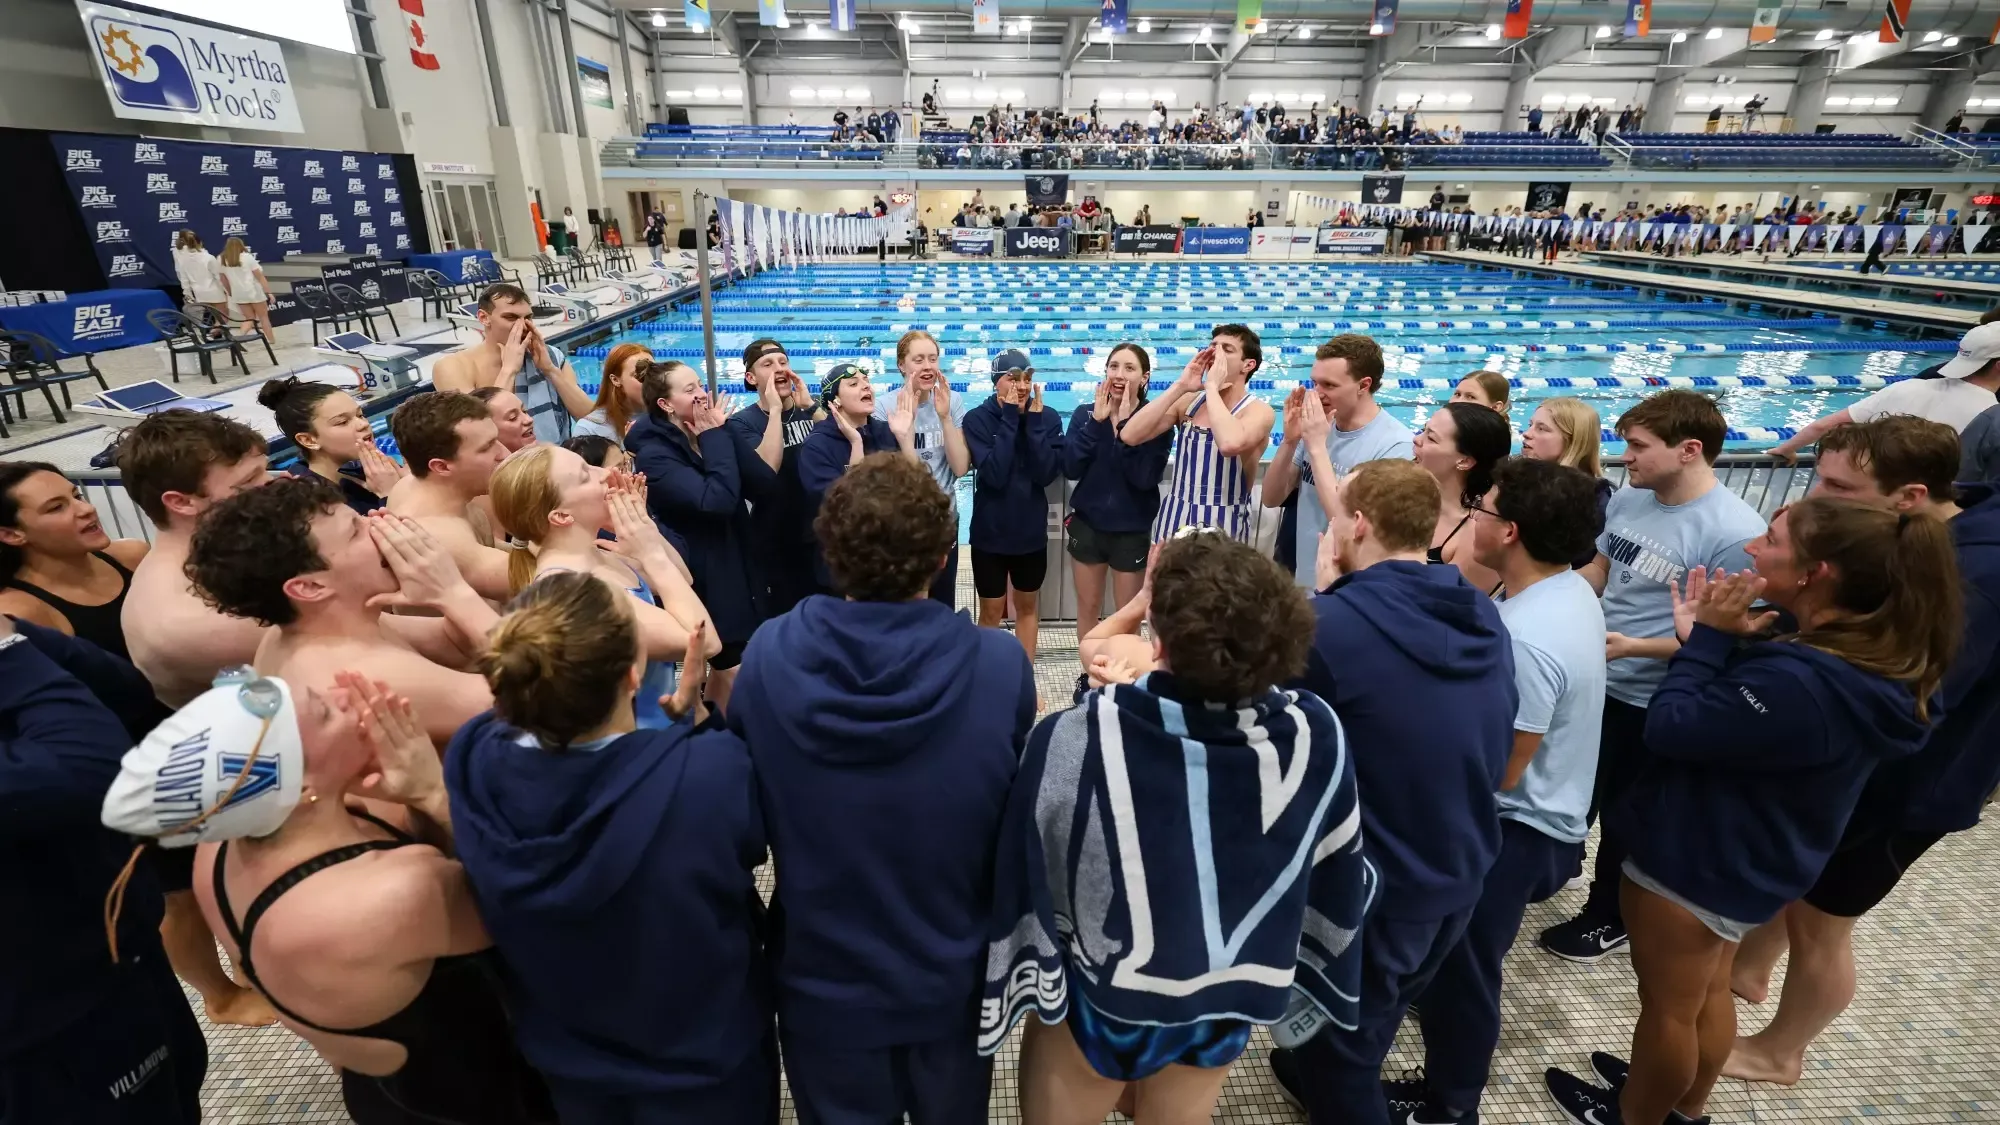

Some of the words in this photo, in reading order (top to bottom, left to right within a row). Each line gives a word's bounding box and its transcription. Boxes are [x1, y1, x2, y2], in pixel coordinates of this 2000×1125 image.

[188, 37, 286, 84] Myrtha
[136, 143, 157, 152] BIG
[67, 150, 92, 158] BIG
[135, 152, 166, 160] EAST
[254, 150, 272, 158] BIG
[66, 158, 102, 167] EAST
[202, 156, 222, 164] BIG
[201, 163, 229, 171] EAST
[147, 173, 168, 182] BIG
[82, 186, 107, 195] BIG
[212, 186, 231, 194] BIG
[82, 194, 116, 203] EAST
[212, 194, 238, 202] EAST
[159, 202, 179, 211] BIG
[270, 201, 286, 209] BIG
[159, 210, 188, 218] EAST
[97, 221, 121, 230] BIG
[223, 224, 248, 232] EAST
[97, 229, 130, 238] EAST
[277, 232, 300, 240] EAST
[1692, 228, 1698, 238] 6
[1829, 230, 1838, 240] 7
[1016, 232, 1060, 252] Jeep
[113, 254, 136, 264] BIG
[111, 262, 145, 273] EAST
[324, 270, 336, 278] 2nd
[667, 278, 673, 286] 4
[624, 292, 632, 300] 5
[277, 301, 296, 309] Place
[75, 304, 112, 320] BIG
[568, 308, 576, 320] 6
[74, 315, 124, 333] EAST
[364, 373, 377, 387] 8
[1622, 527, 1672, 556] WILDCATS
[1739, 686, 1769, 713] FEGLEY
[108, 1045, 169, 1099] VILLANOVA
